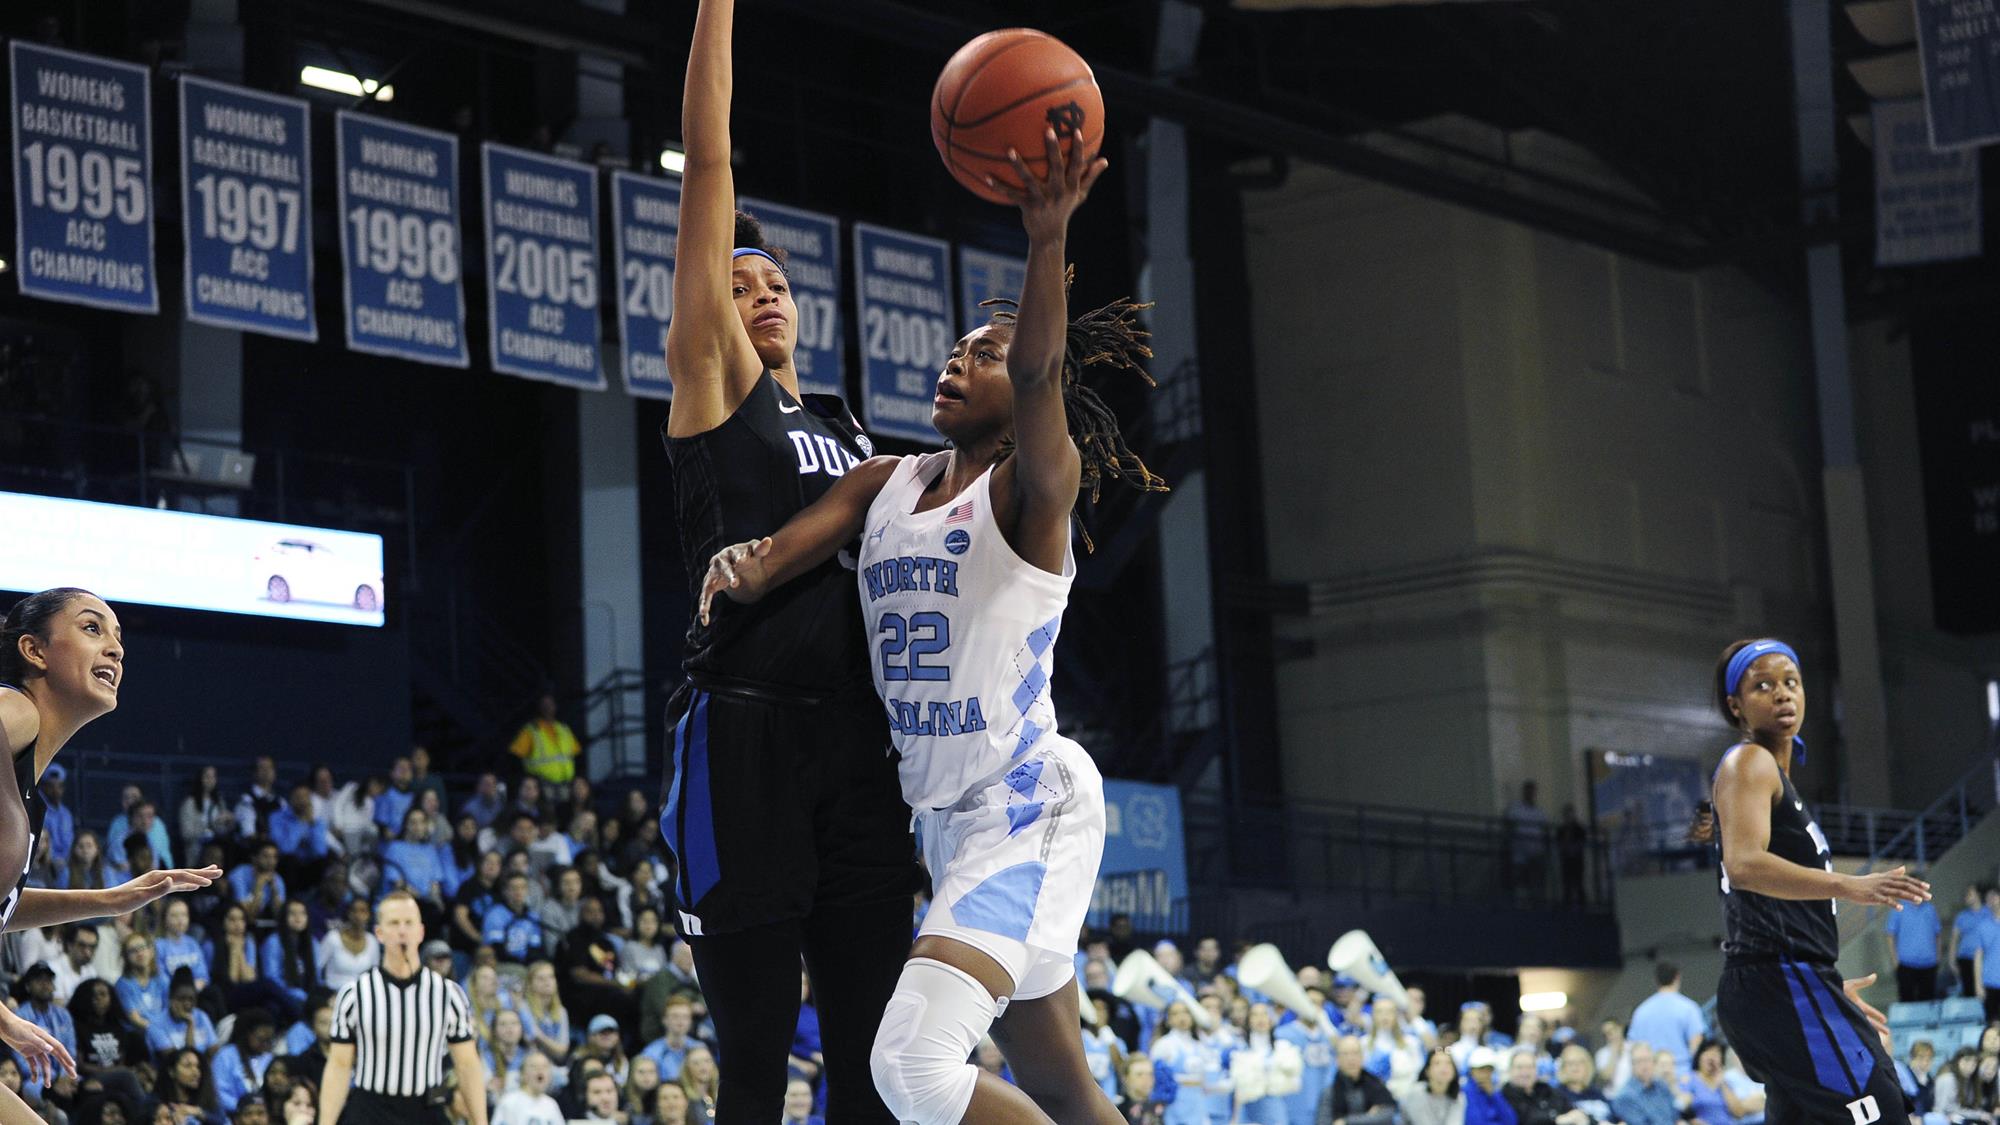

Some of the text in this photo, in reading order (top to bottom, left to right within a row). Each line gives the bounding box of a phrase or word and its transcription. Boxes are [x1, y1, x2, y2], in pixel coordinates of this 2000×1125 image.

[22, 103, 138, 151] BASKETBALL
[193, 135, 300, 184] BASKETBALL
[23, 141, 146, 225] 1995
[350, 168, 451, 214] BASKETBALL
[66, 218, 107, 251] ACC
[195, 174, 300, 253] 1997
[494, 201, 591, 245] BASKETBALL
[230, 247, 270, 281] ACC
[349, 206, 458, 284] 1998
[30, 248, 144, 294] CHAMPIONS
[385, 278, 424, 310] ACC
[494, 233, 597, 309] 2005
[624, 259, 673, 322] 20
[197, 275, 307, 321] CHAMPIONS
[528, 303, 565, 335] ACC
[796, 290, 837, 350] 07
[355, 305, 457, 349] CHAMPIONS
[501, 328, 594, 372] CHAMPIONS
[864, 556, 959, 602] NORTH
[879, 611, 950, 682] 22
[887, 697, 987, 737] OLINA
